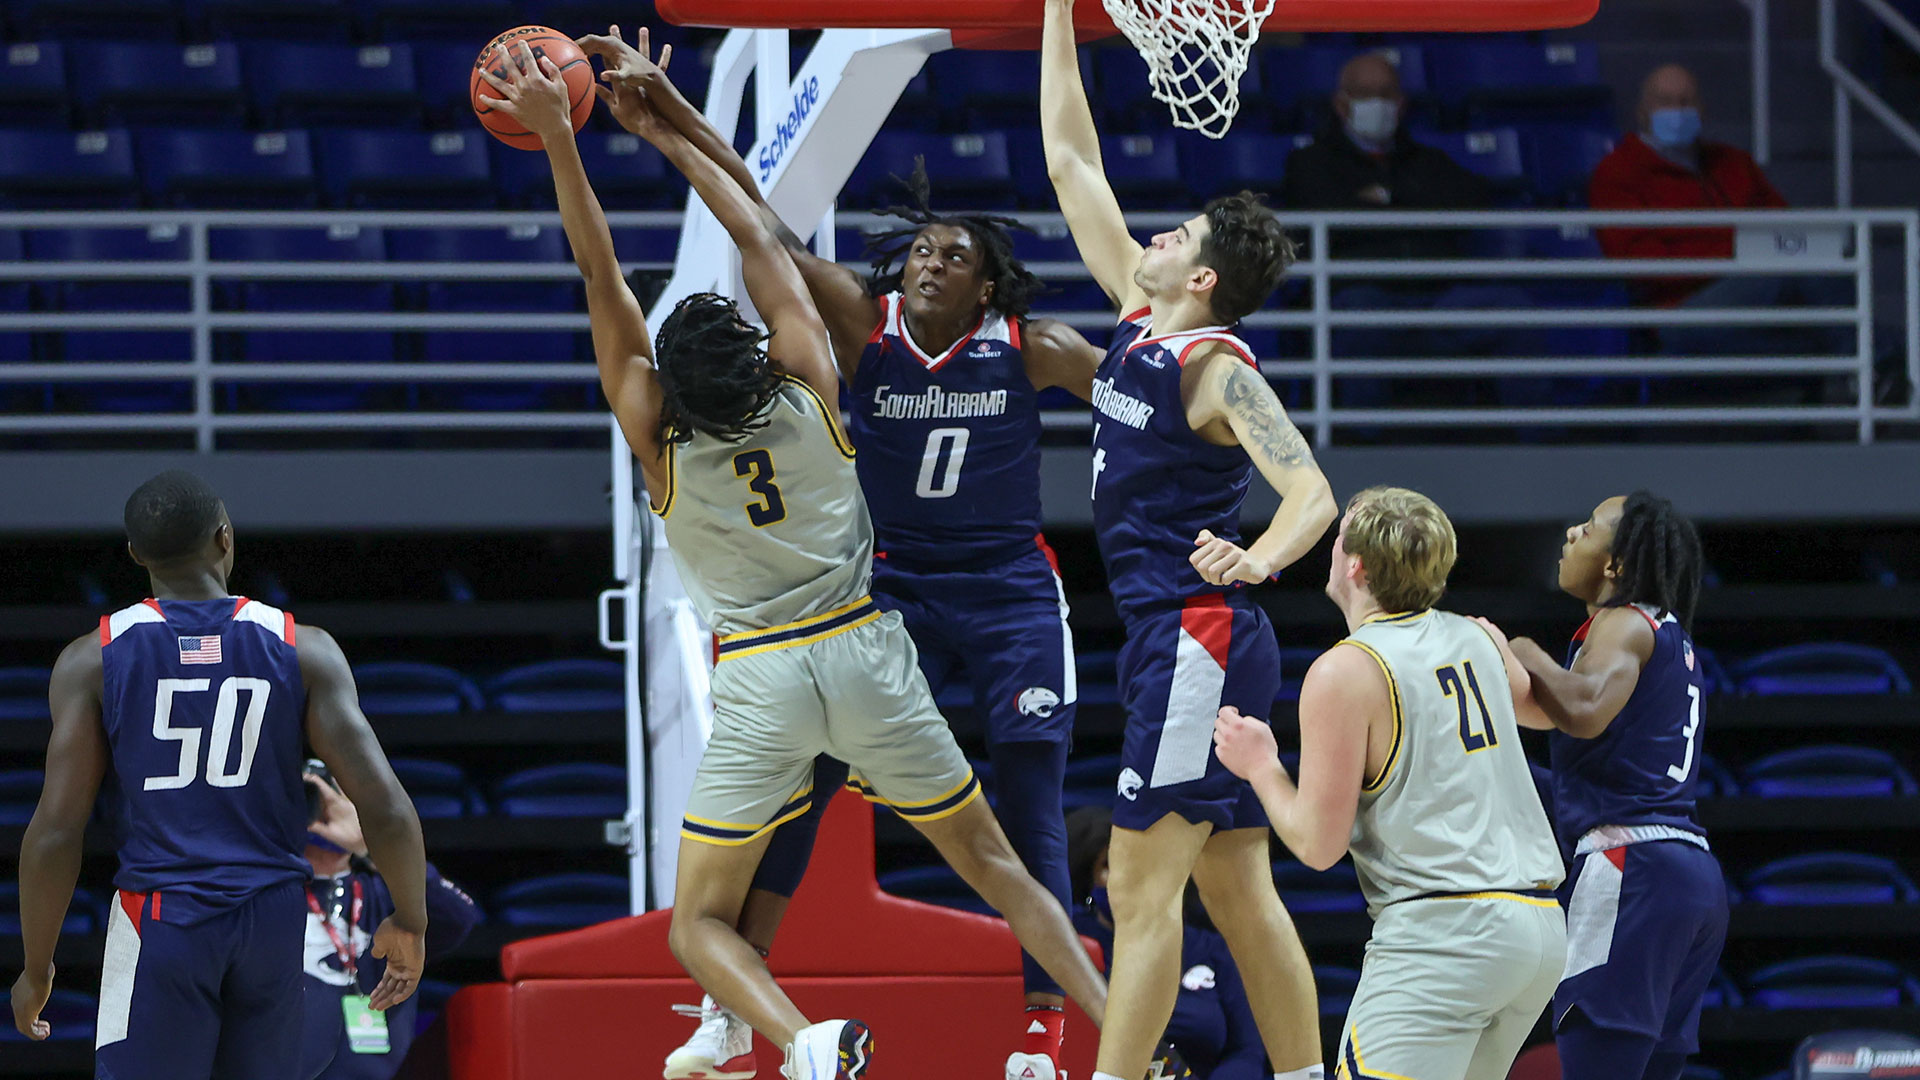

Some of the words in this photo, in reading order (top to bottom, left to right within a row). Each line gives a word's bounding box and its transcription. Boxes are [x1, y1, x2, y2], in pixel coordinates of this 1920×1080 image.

[760, 75, 820, 183] Schelde
[732, 447, 788, 528] 3
[916, 427, 970, 498] 0
[143, 676, 271, 791] 50
[1434, 659, 1499, 754] 21
[1667, 683, 1700, 783] 3
